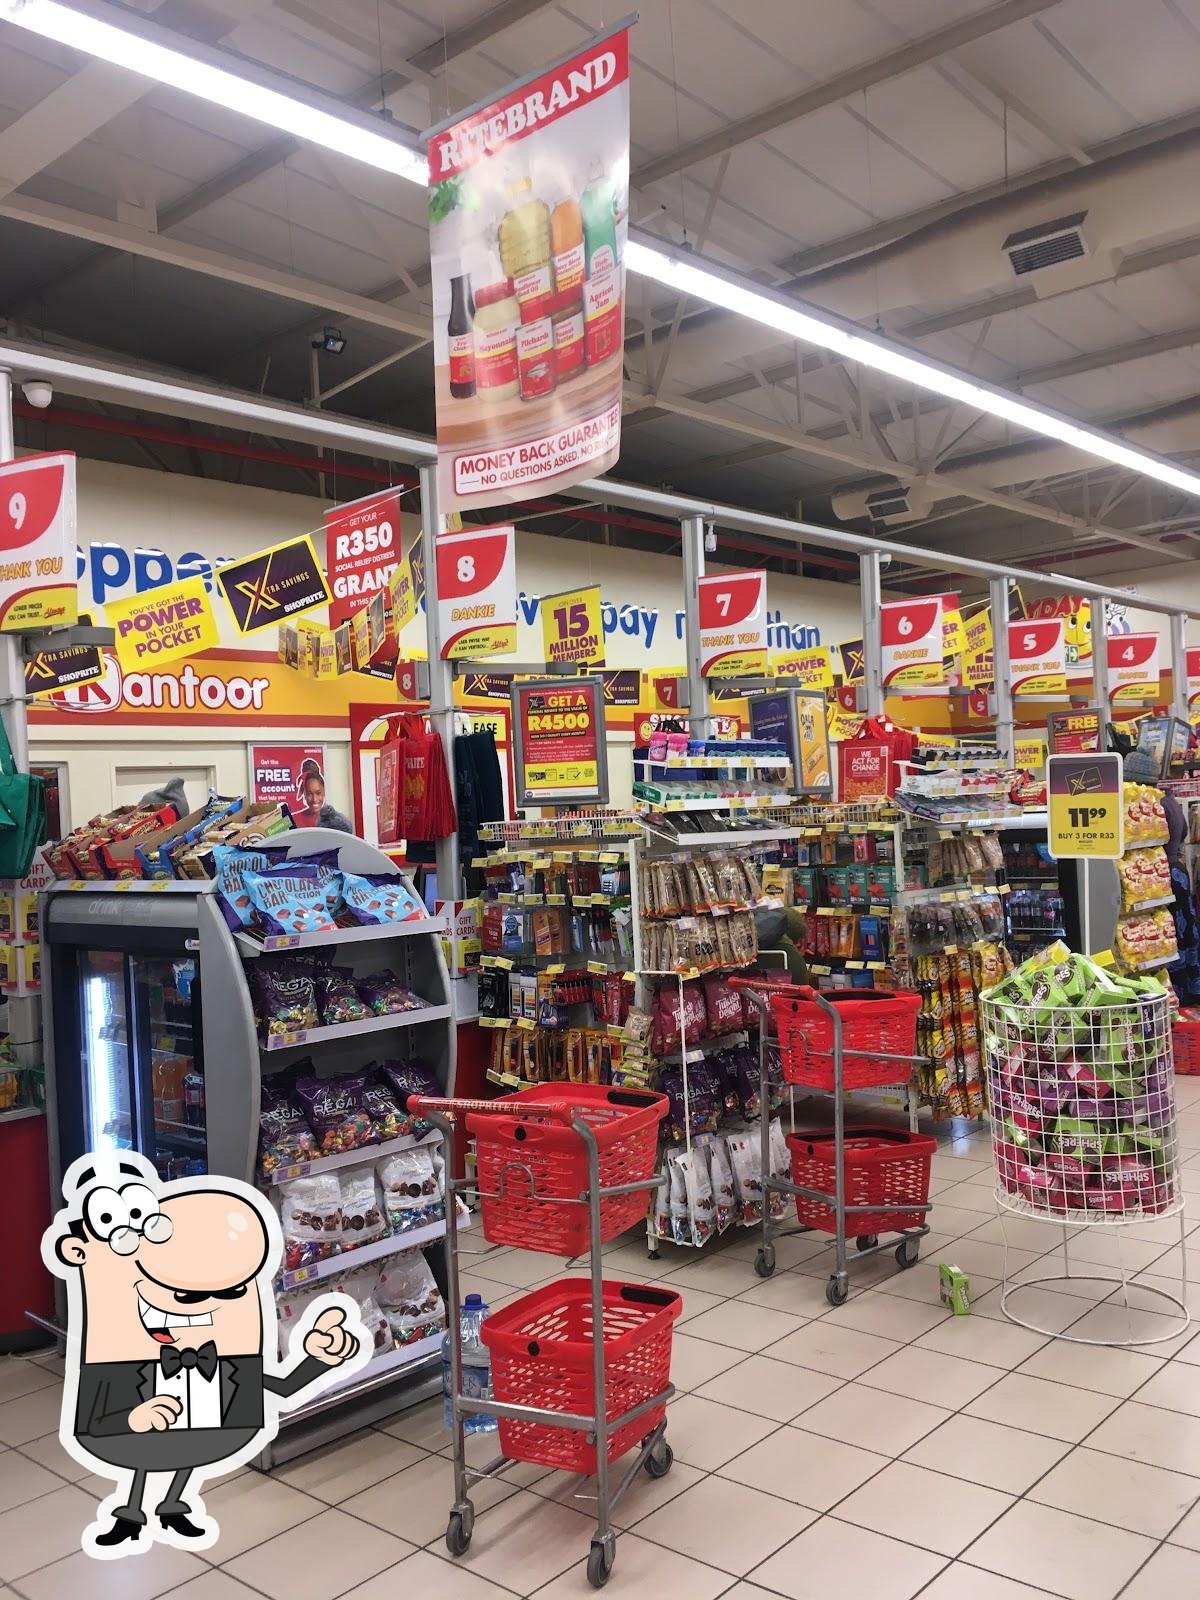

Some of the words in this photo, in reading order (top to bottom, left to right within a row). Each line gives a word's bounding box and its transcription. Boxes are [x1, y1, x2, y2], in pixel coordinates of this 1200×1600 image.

[438, 51, 616, 172] RITEBRAND
[589, 284, 614, 304] Apricot
[595, 298, 610, 310] Jam
[520, 332, 549, 348] Pilchards
[460, 452, 516, 476] MONEY
[519, 440, 556, 463] BACK
[557, 408, 619, 451] GUARANTEE
[480, 474, 497, 486] NO
[499, 461, 552, 482] QUESTIONS
[8, 492, 27, 530] 9
[349, 514, 361, 527] GET
[361, 512, 377, 524] YOUR
[336, 522, 393, 562] R350
[35, 556, 63, 577] YOU
[335, 561, 354, 573] SOCIAL
[354, 557, 372, 568] RELIEF
[372, 550, 396, 564] DISTRESS
[457, 555, 476, 583] 8
[282, 572, 310, 590] SAVINGS
[128, 604, 155, 617] YOU'VE
[156, 599, 171, 610] GOT
[172, 594, 185, 605] THE
[284, 591, 325, 613] SHOPRITE
[349, 599, 358, 608] IN
[715, 592, 732, 617] 7
[117, 597, 205, 639] POWER
[451, 604, 496, 622] DANKIE
[553, 603, 590, 640] 15
[145, 629, 157, 639] IN
[158, 622, 185, 637] YOUR
[897, 616, 913, 636] 6
[134, 624, 202, 658] POCKET
[549, 634, 599, 655] MILLION
[702, 635, 734, 648] THANK
[737, 632, 760, 645] YOU
[1023, 633, 1037, 651] 5
[552, 647, 597, 662] MEMBERS
[1122, 645, 1134, 661] 4
[58, 665, 99, 684] SHOPRITE
[777, 657, 826, 675] POWER
[402, 673, 412, 690] 8
[548, 695, 572, 707] GET
[576, 694, 586, 706] A
[663, 686, 673, 701] 7
[844, 694, 853, 706] 6
[976, 700, 985, 712] 5
[527, 712, 590, 731] R4500
[1068, 716, 1098, 731] FREE
[852, 757, 865, 765] ACT
[861, 750, 872, 758] WE
[256, 768, 291, 783] FREE
[261, 784, 296, 793] account
[263, 892, 289, 909] BAR
[459, 916, 472, 926] GIFT
[456, 926, 475, 936] CARDS
[313, 1097, 359, 1116] REGAL
[1059, 1135, 1103, 1149] SPHERES
[1105, 1172, 1150, 1182] SPHERES
